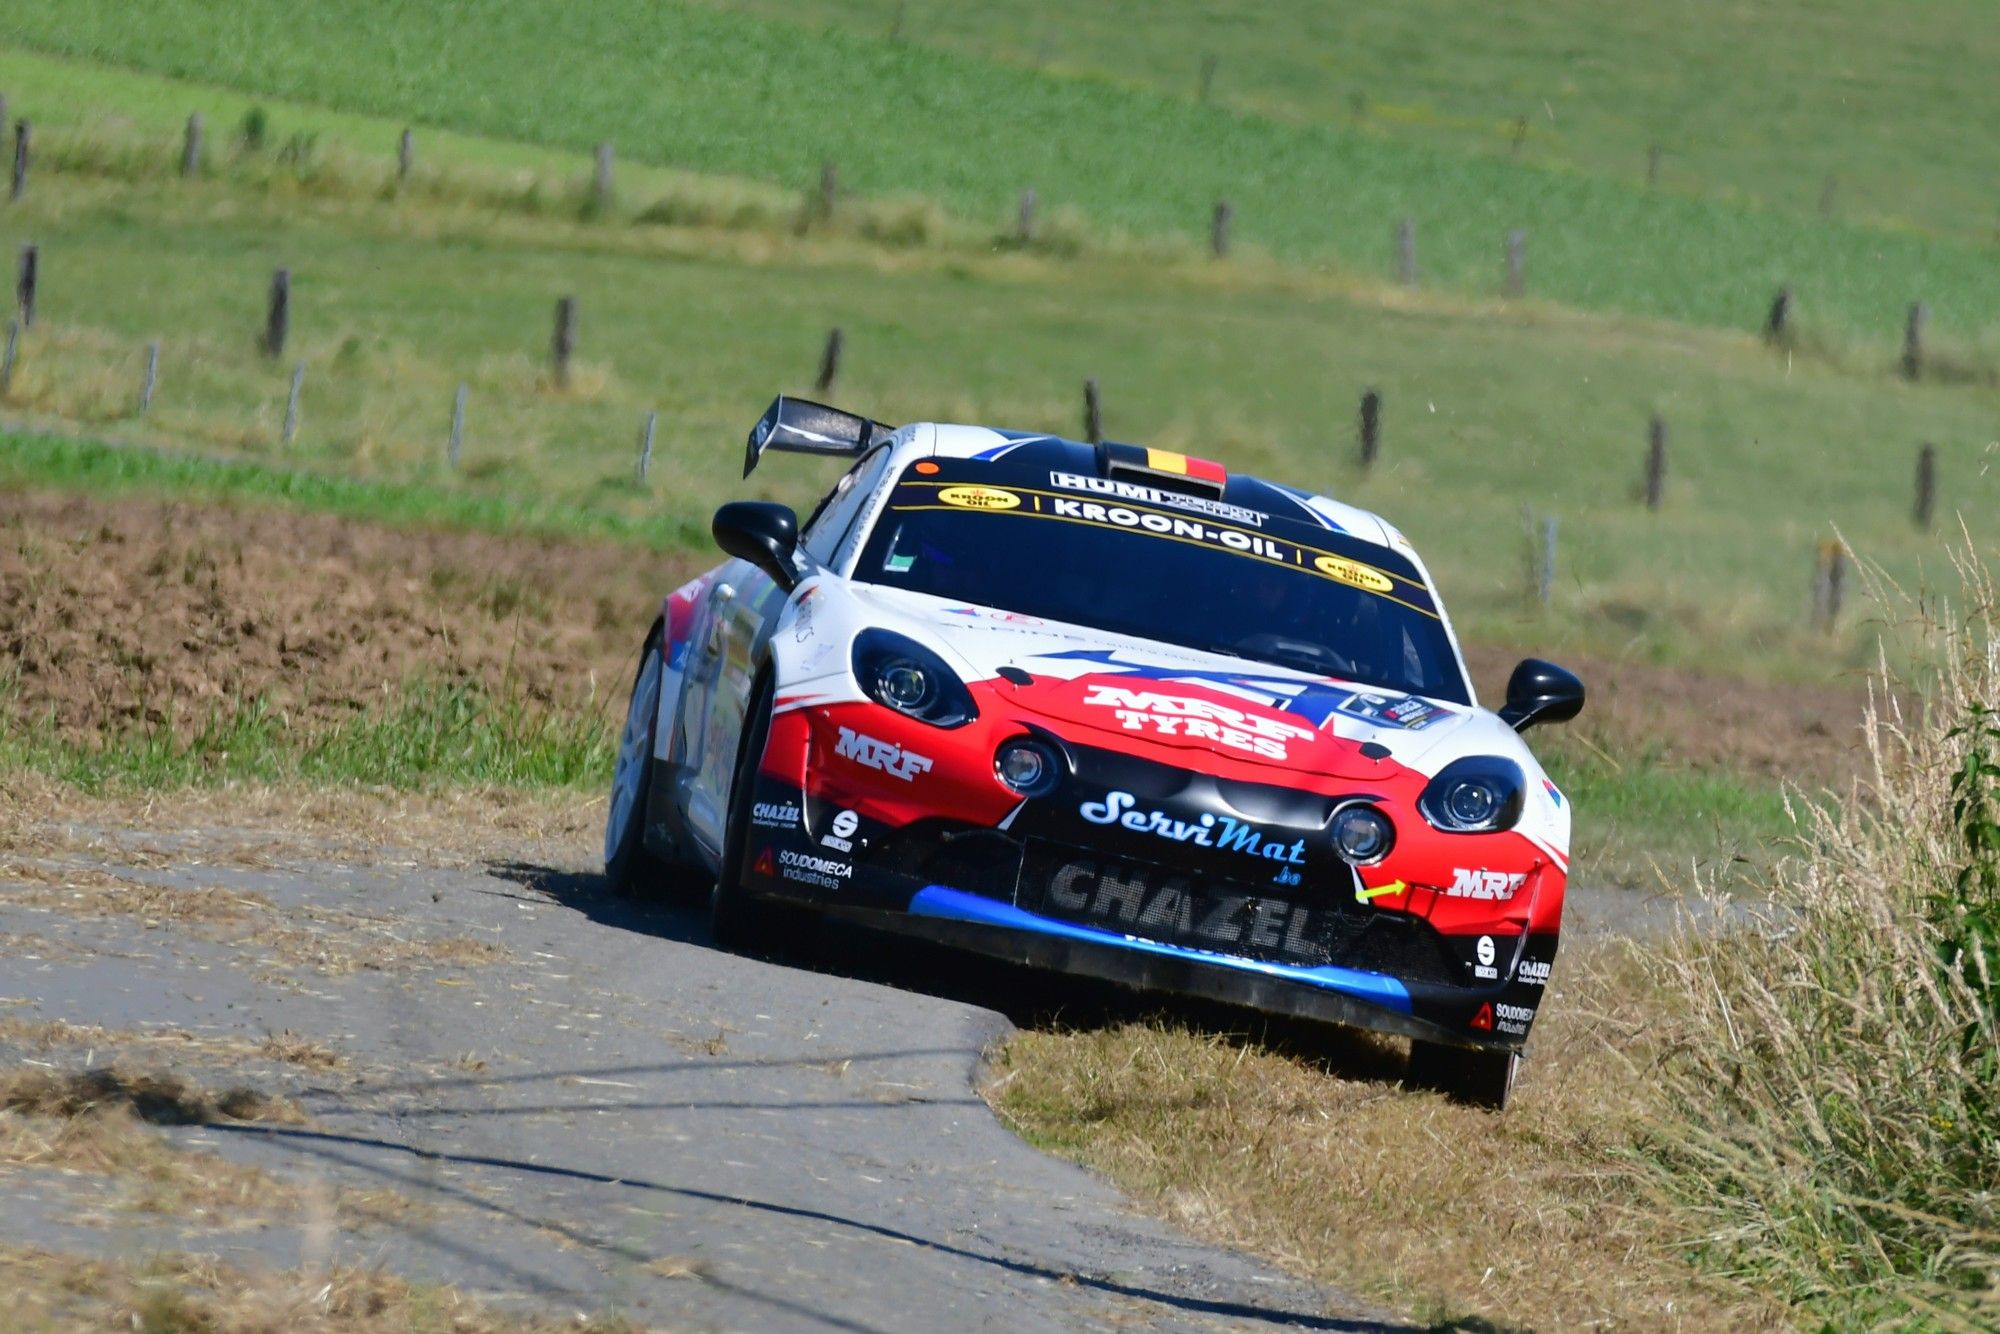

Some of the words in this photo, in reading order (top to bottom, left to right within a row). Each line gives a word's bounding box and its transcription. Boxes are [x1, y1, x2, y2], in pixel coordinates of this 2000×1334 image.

[1054, 498, 1284, 561] KROON-OIL
[1083, 685, 1314, 742] MRF
[1115, 709, 1288, 760] TYRES
[834, 726, 934, 782] MRF
[753, 803, 800, 822] CHAZEL
[779, 849, 853, 879] SOUDOMECA
[783, 867, 840, 890] industries
[1447, 868, 1526, 900] MRF
[1050, 862, 1331, 963] CHAZEL
